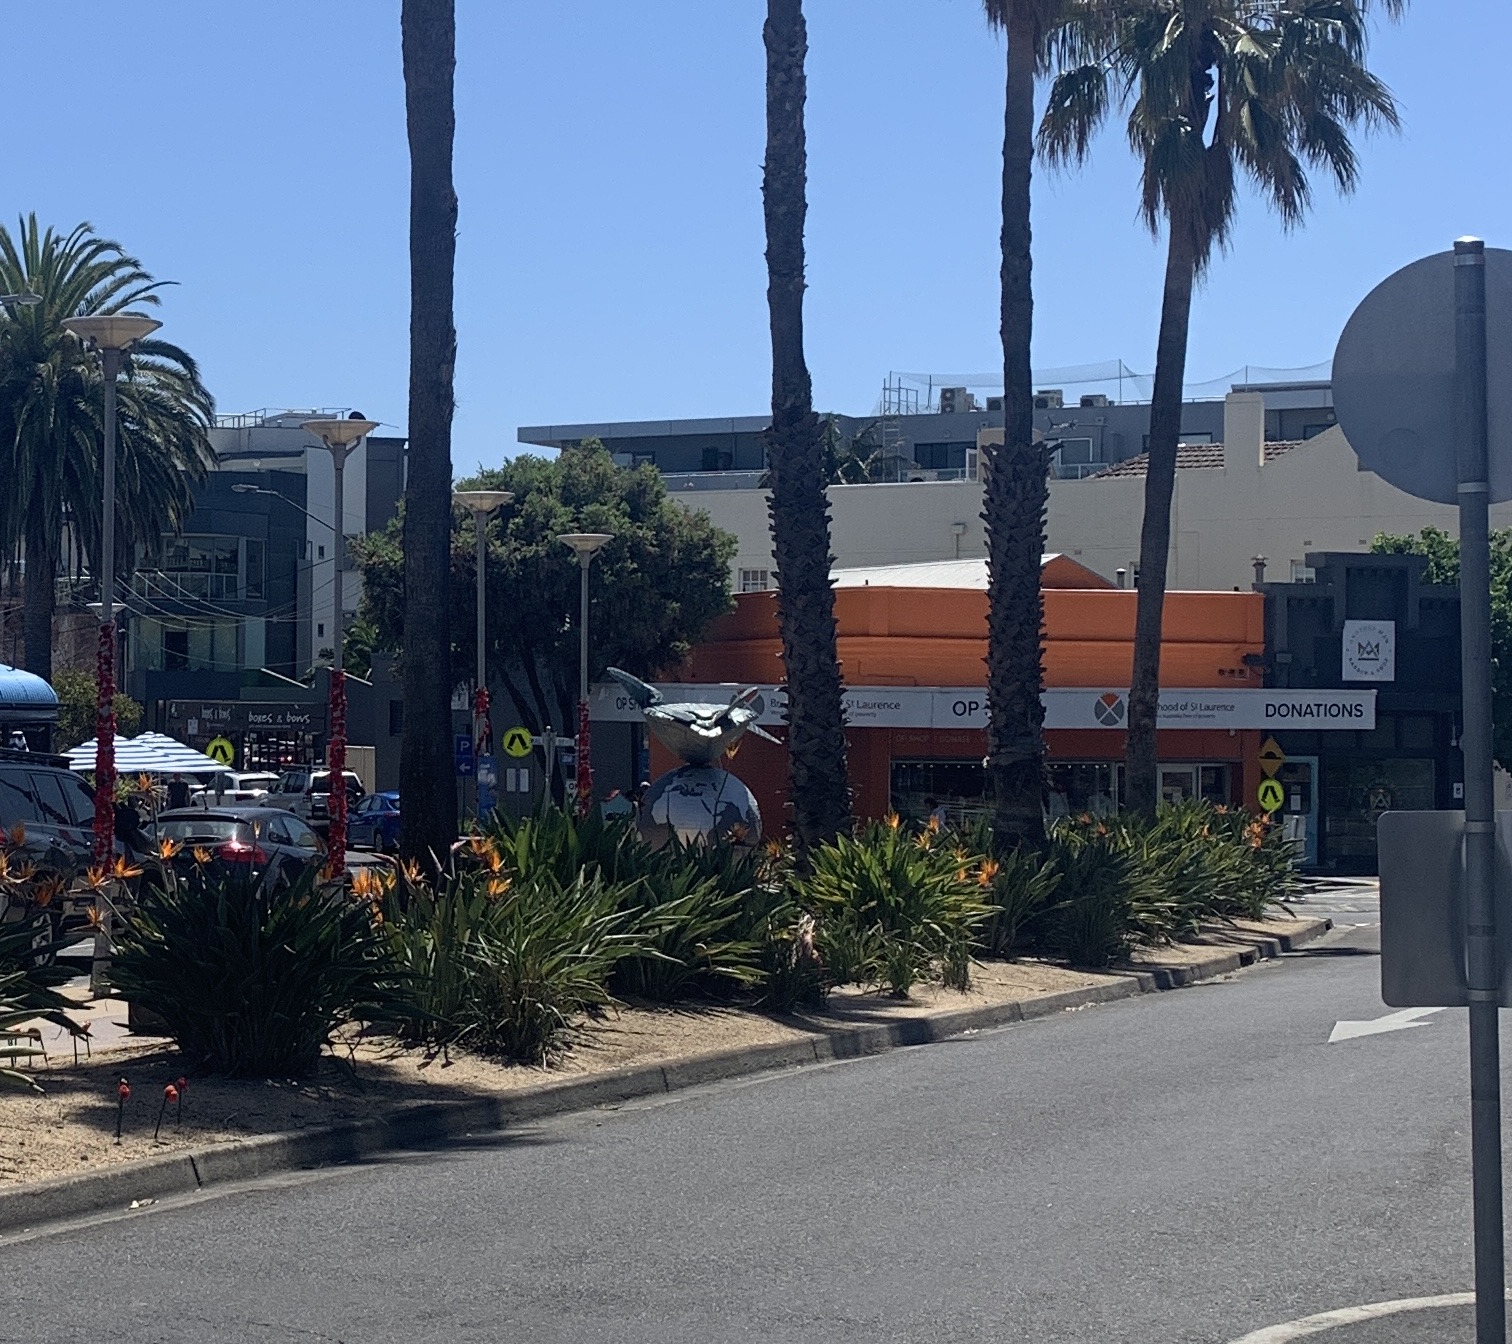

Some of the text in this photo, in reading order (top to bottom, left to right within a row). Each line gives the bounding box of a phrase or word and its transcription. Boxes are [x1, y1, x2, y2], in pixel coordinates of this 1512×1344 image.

[616, 696, 627, 710] OP
[856, 699, 901, 711] Laurence
[952, 700, 980, 717] OP
[1179, 701, 1188, 712] of
[1199, 702, 1236, 713] Laurence
[1265, 702, 1364, 718] DONATIONS
[248, 711, 311, 724] boxes & bows
[460, 741, 470, 751] P
